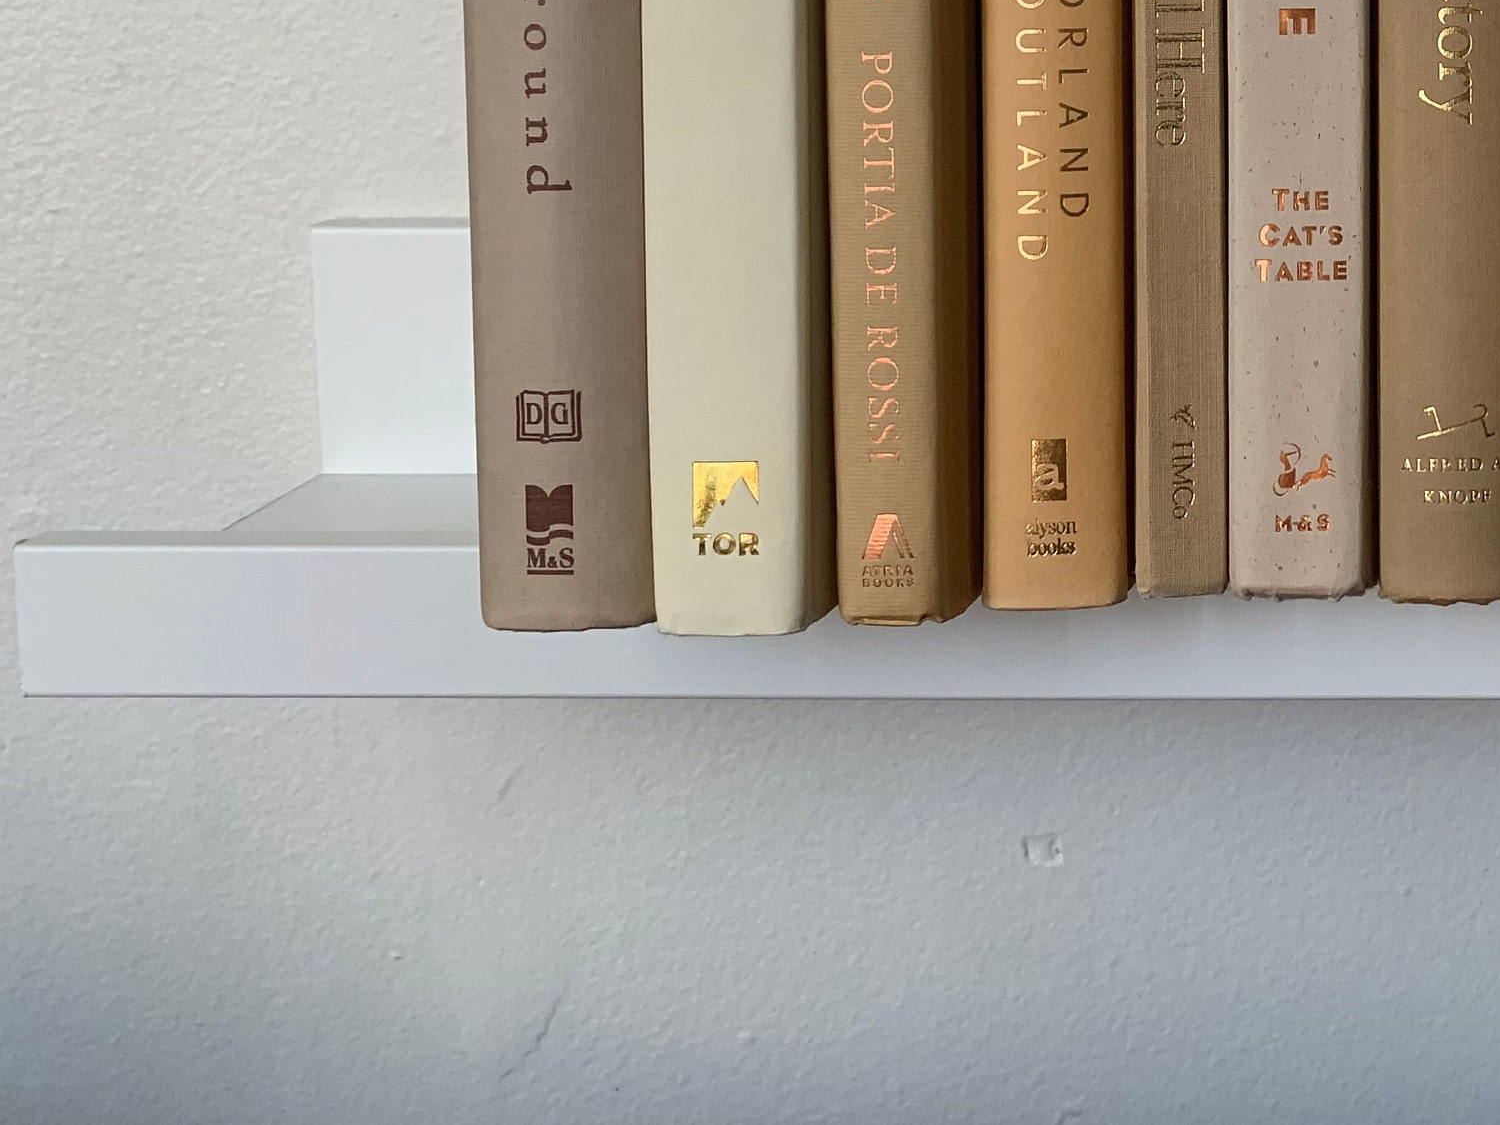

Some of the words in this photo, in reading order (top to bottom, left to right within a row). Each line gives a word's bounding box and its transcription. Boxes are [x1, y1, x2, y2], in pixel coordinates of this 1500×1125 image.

[1155, 28, 1205, 147] Here
[861, 51, 897, 229] PORTIA
[1271, 188, 1330, 211] THE
[1258, 223, 1344, 247] CAT'S
[865, 248, 898, 305] DE
[1254, 258, 1348, 282] TABLE
[866, 325, 900, 463] ROSSI
[1400, 457, 1484, 473] ALFRED
[1423, 487, 1492, 504] KNOPF
[1024, 518, 1077, 540] alyson
[693, 533, 760, 556] TOR
[1026, 538, 1077, 557] books
[527, 548, 575, 568] M&S
[862, 565, 914, 576] ATRIA
[862, 578, 914, 588] BOOKS
